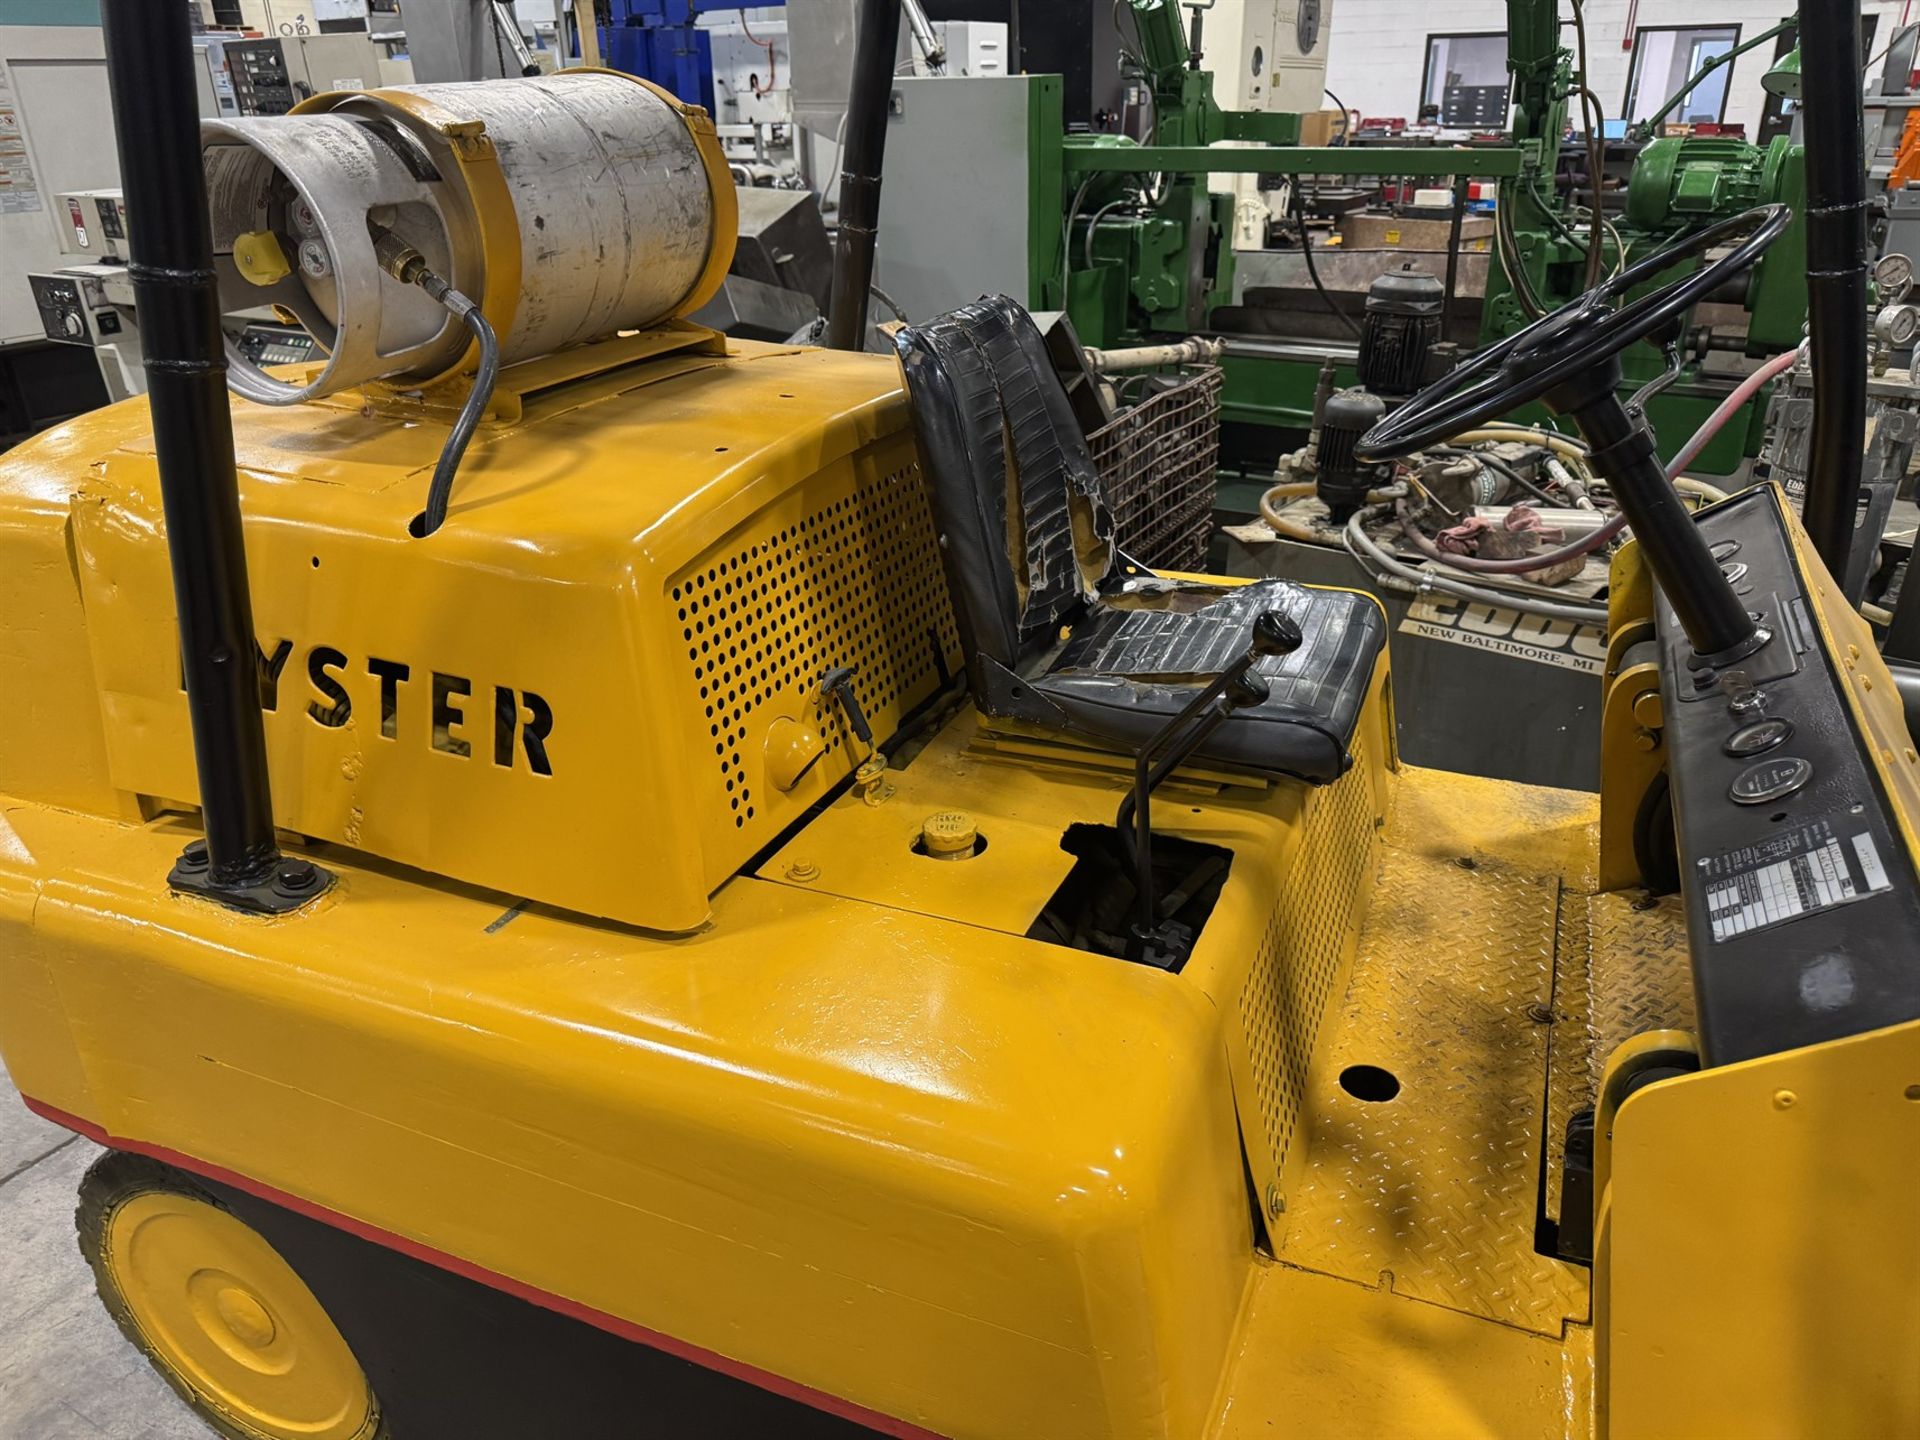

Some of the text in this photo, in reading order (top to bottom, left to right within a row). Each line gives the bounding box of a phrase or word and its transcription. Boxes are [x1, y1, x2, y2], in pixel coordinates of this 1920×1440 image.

[1417, 624, 1456, 639] NEW
[1572, 658, 1595, 671] MI
[181, 638, 554, 776] YSTER
